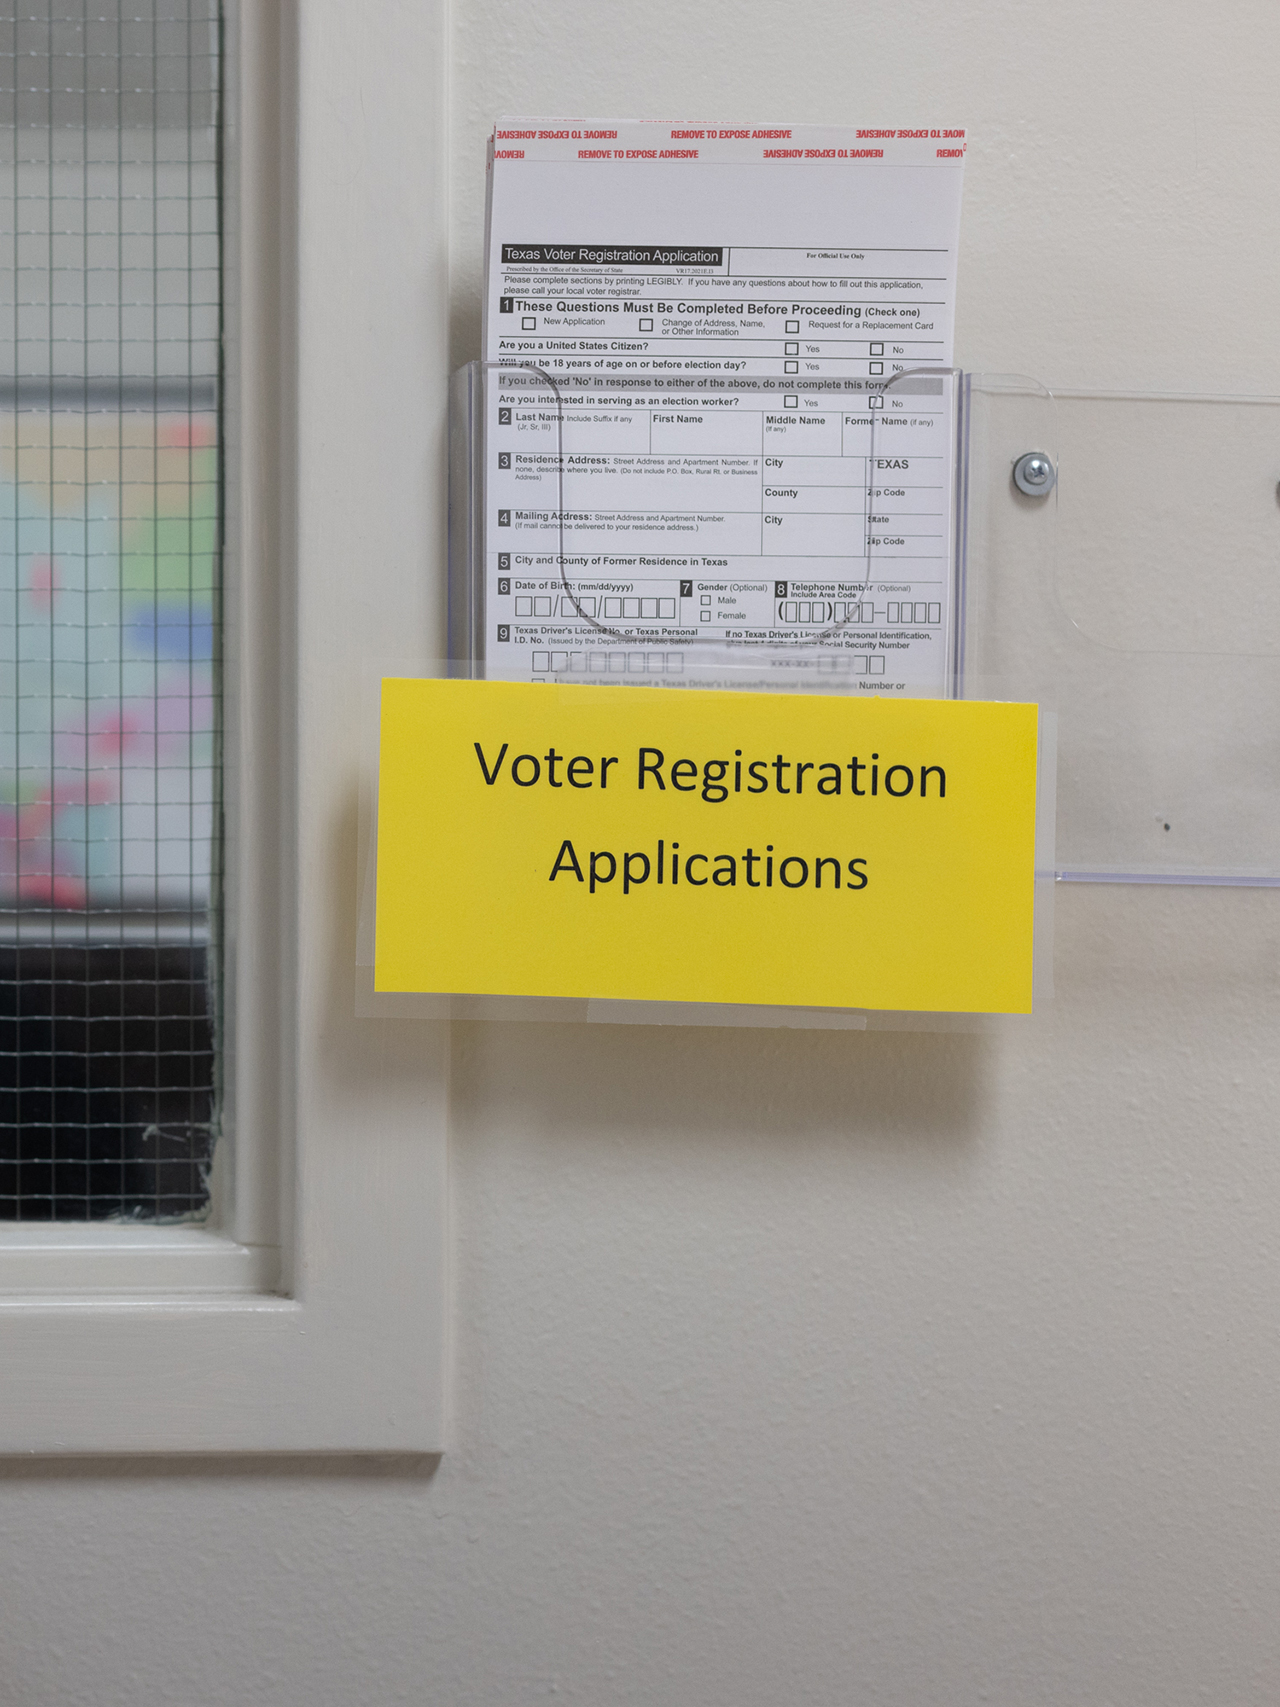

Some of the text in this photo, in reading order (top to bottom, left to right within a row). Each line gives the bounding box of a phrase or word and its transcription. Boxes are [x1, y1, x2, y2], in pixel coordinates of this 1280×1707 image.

[496, 129, 618, 139] REMOVE TO EXPOSE ADHESIVE
[670, 129, 792, 139] REMOVE TO EXPOSE ADHESIVE
[504, 248, 718, 262] Texas Voter Registration Application
[503, 299, 920, 318] 1 These Questions Must Be Completed Before Proceeding (Check one)
[543, 317, 605, 326] New Application
[808, 320, 841, 330] Request
[842, 320, 853, 329] for
[862, 320, 913, 330] Replacement
[914, 321, 934, 330] Card
[498, 340, 516, 349] Are
[517, 342, 536, 351] you
[546, 340, 576, 350] United
[578, 341, 608, 350] States
[610, 341, 649, 350] Citizen?
[805, 344, 820, 353] Yes
[892, 346, 904, 354] No
[652, 414, 703, 423] First Name
[766, 415, 826, 425] Middle Name
[764, 457, 784, 468] City
[764, 487, 798, 499] County
[594, 513, 615, 521] Street
[659, 514, 696, 522] Apartment
[764, 515, 783, 526] City
[500, 555, 728, 568] 5 City and County of Former Residence in Texas
[682, 582, 768, 594] 7 Gender (Optional)
[717, 596, 737, 604] Male
[717, 611, 746, 620] Female
[858, 681, 894, 690] Number
[473, 742, 946, 803] Voter Registration
[548, 839, 868, 895] Applications
